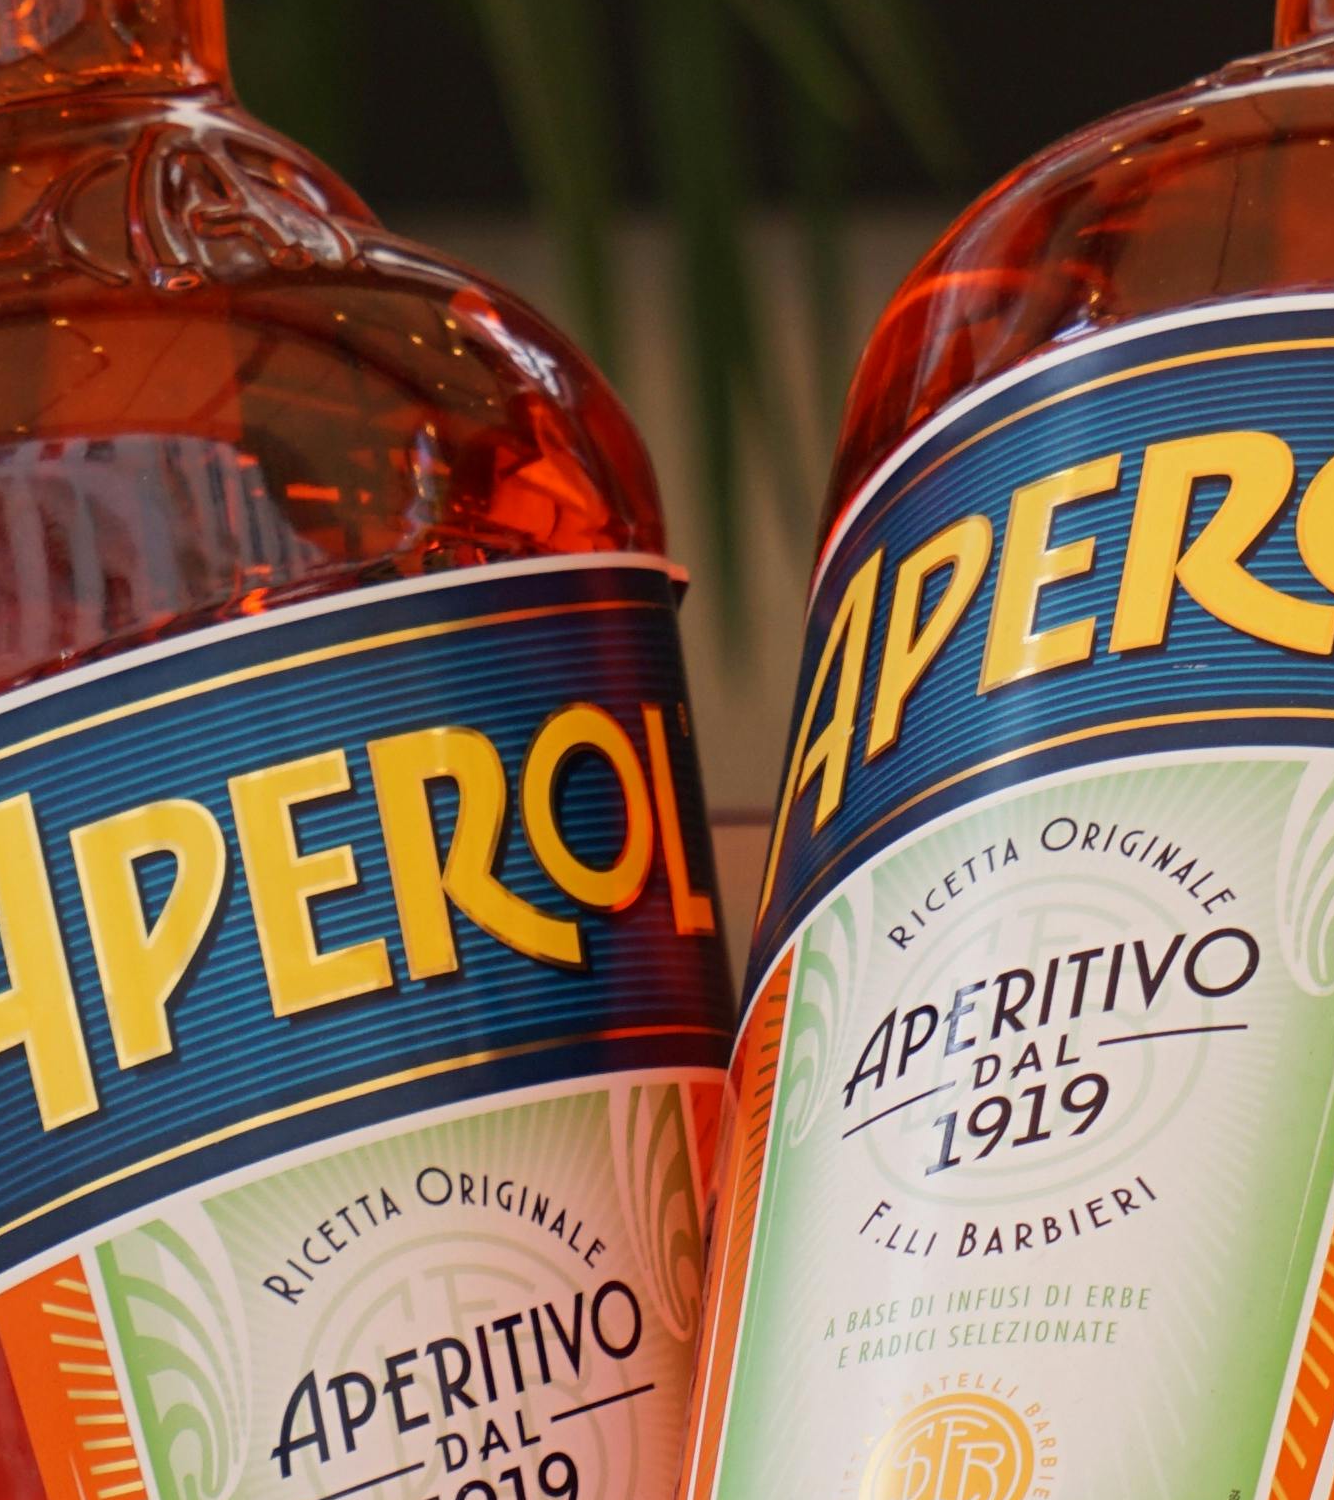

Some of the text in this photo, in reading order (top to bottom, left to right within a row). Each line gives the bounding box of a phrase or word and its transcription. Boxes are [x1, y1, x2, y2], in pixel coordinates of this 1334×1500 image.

[887, 817, 1237, 951] RICETTA ORIGINALE
[843, 927, 1261, 1109] APERITIVO
[972, 1034, 1081, 1088] DAL
[924, 1072, 1111, 1177] 1919
[262, 1166, 607, 1305] RICETTA ORIGINALE
[859, 1176, 1157, 1258] F.LLI BARBIERI
[824, 1284, 1152, 1341] A BASE DI INFUSI DI ERBE
[837, 1320, 1119, 1369] E RADICI SELEZIONATE
[270, 1280, 643, 1478] APERITIVO
[435, 1410, 542, 1473] DAL
